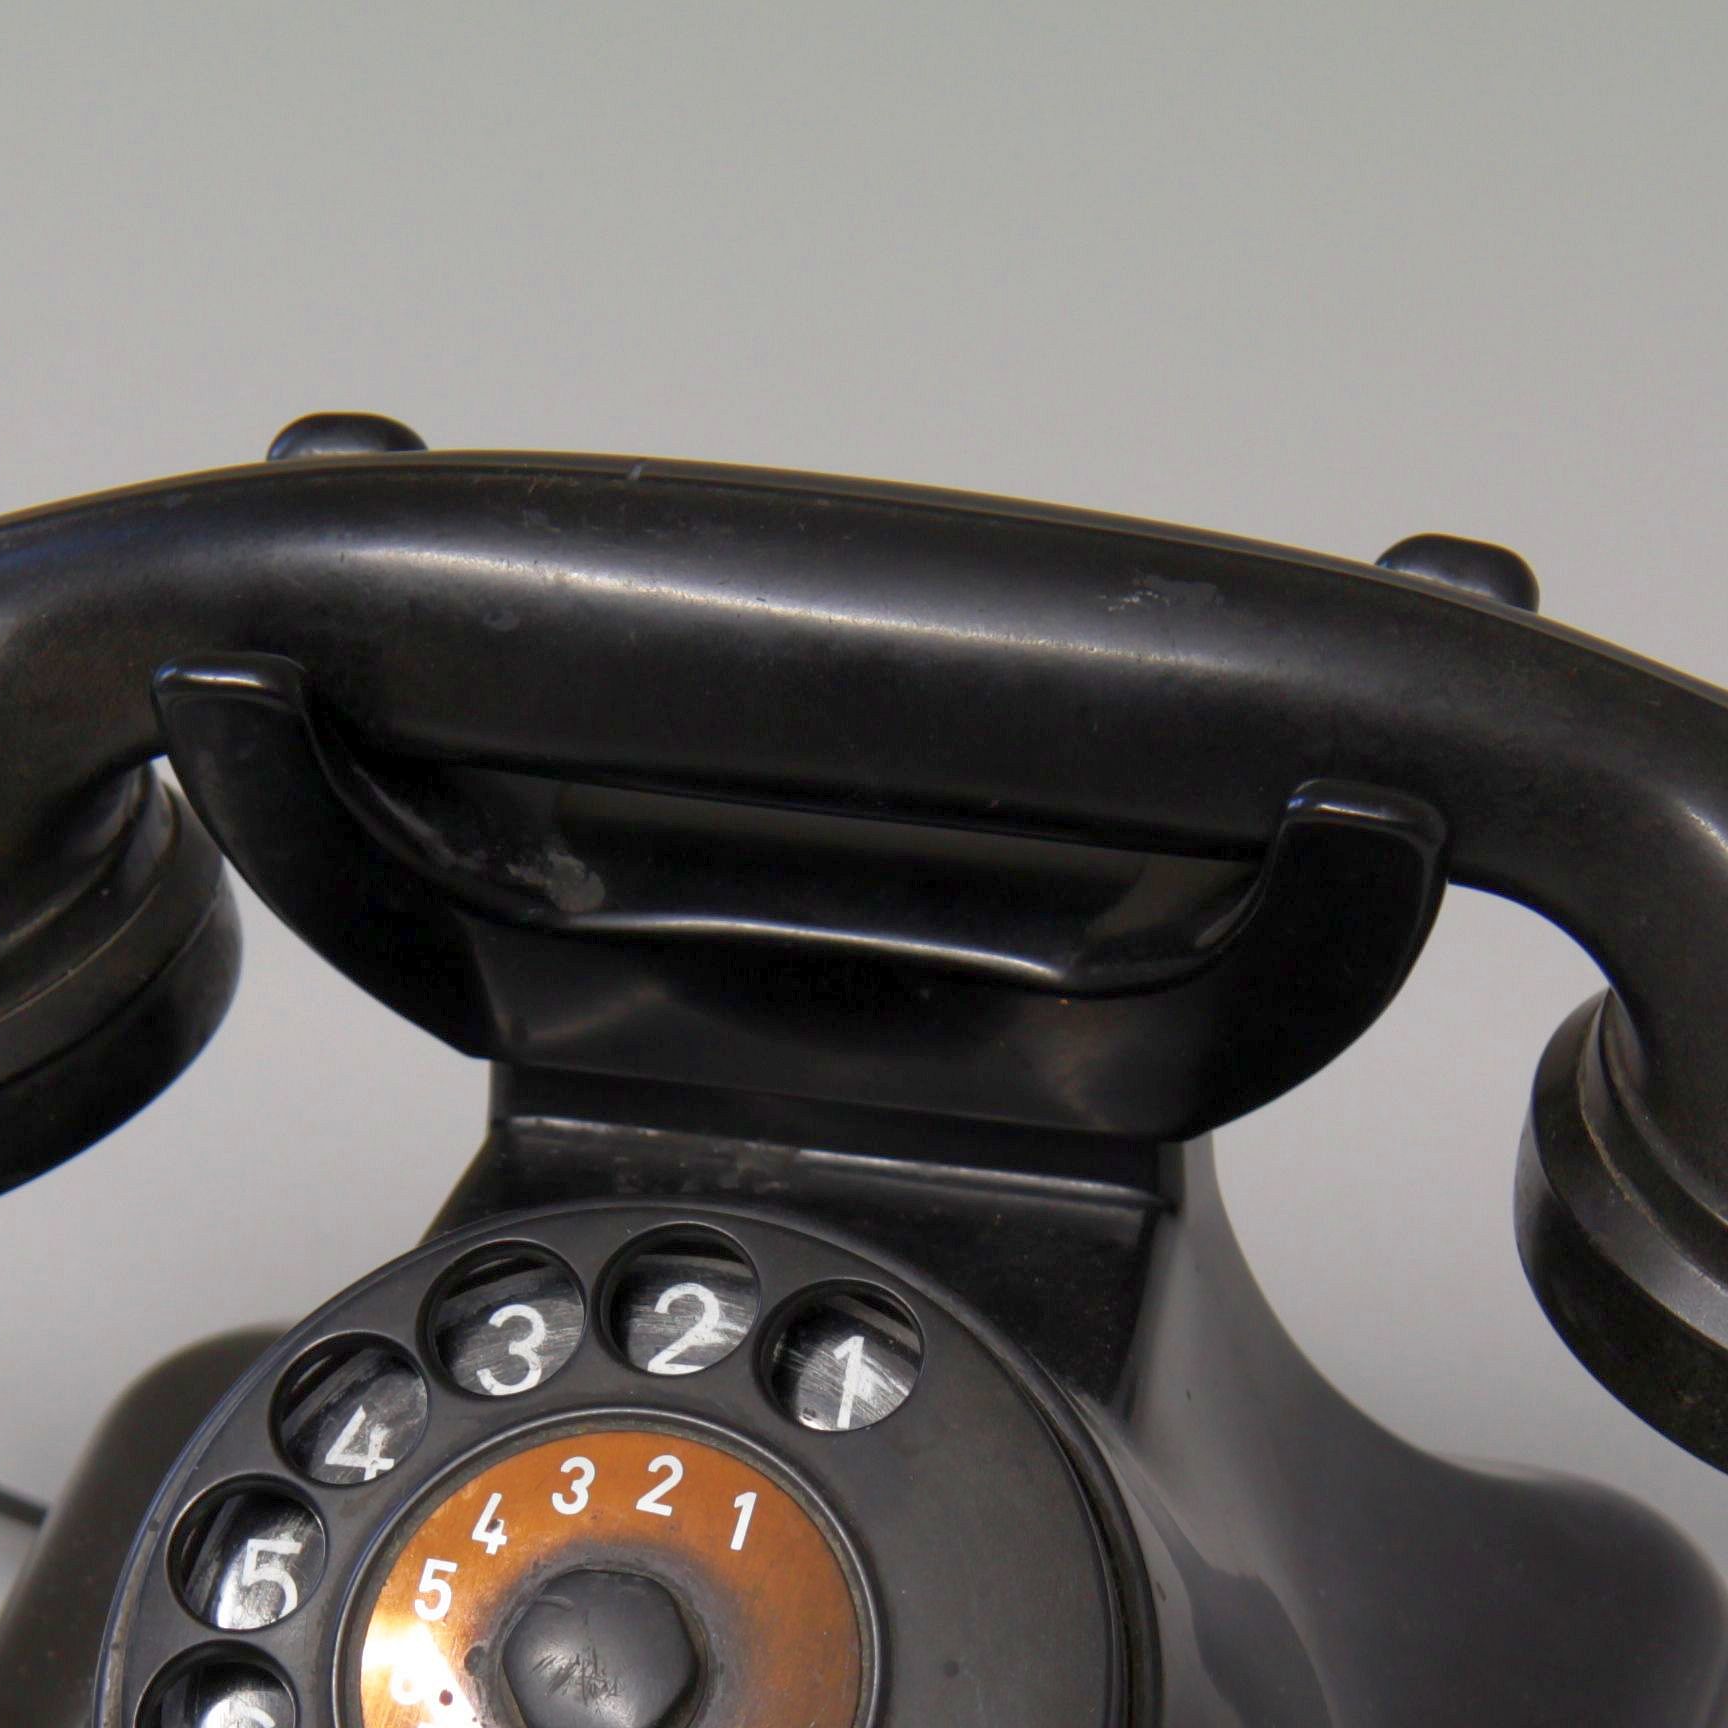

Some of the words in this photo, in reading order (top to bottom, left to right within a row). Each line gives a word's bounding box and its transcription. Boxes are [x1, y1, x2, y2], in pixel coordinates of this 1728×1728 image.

[476, 1304, 547, 1396] 3
[646, 1282, 721, 1375] 2
[833, 1335, 866, 1430] 1
[325, 1404, 394, 1481] 4
[551, 1456, 596, 1515] 3
[635, 1454, 684, 1516] 2
[471, 1493, 508, 1555] 4
[730, 1492, 757, 1551] 1
[241, 1538, 302, 1619] 5
[414, 1558, 458, 1621] 5
